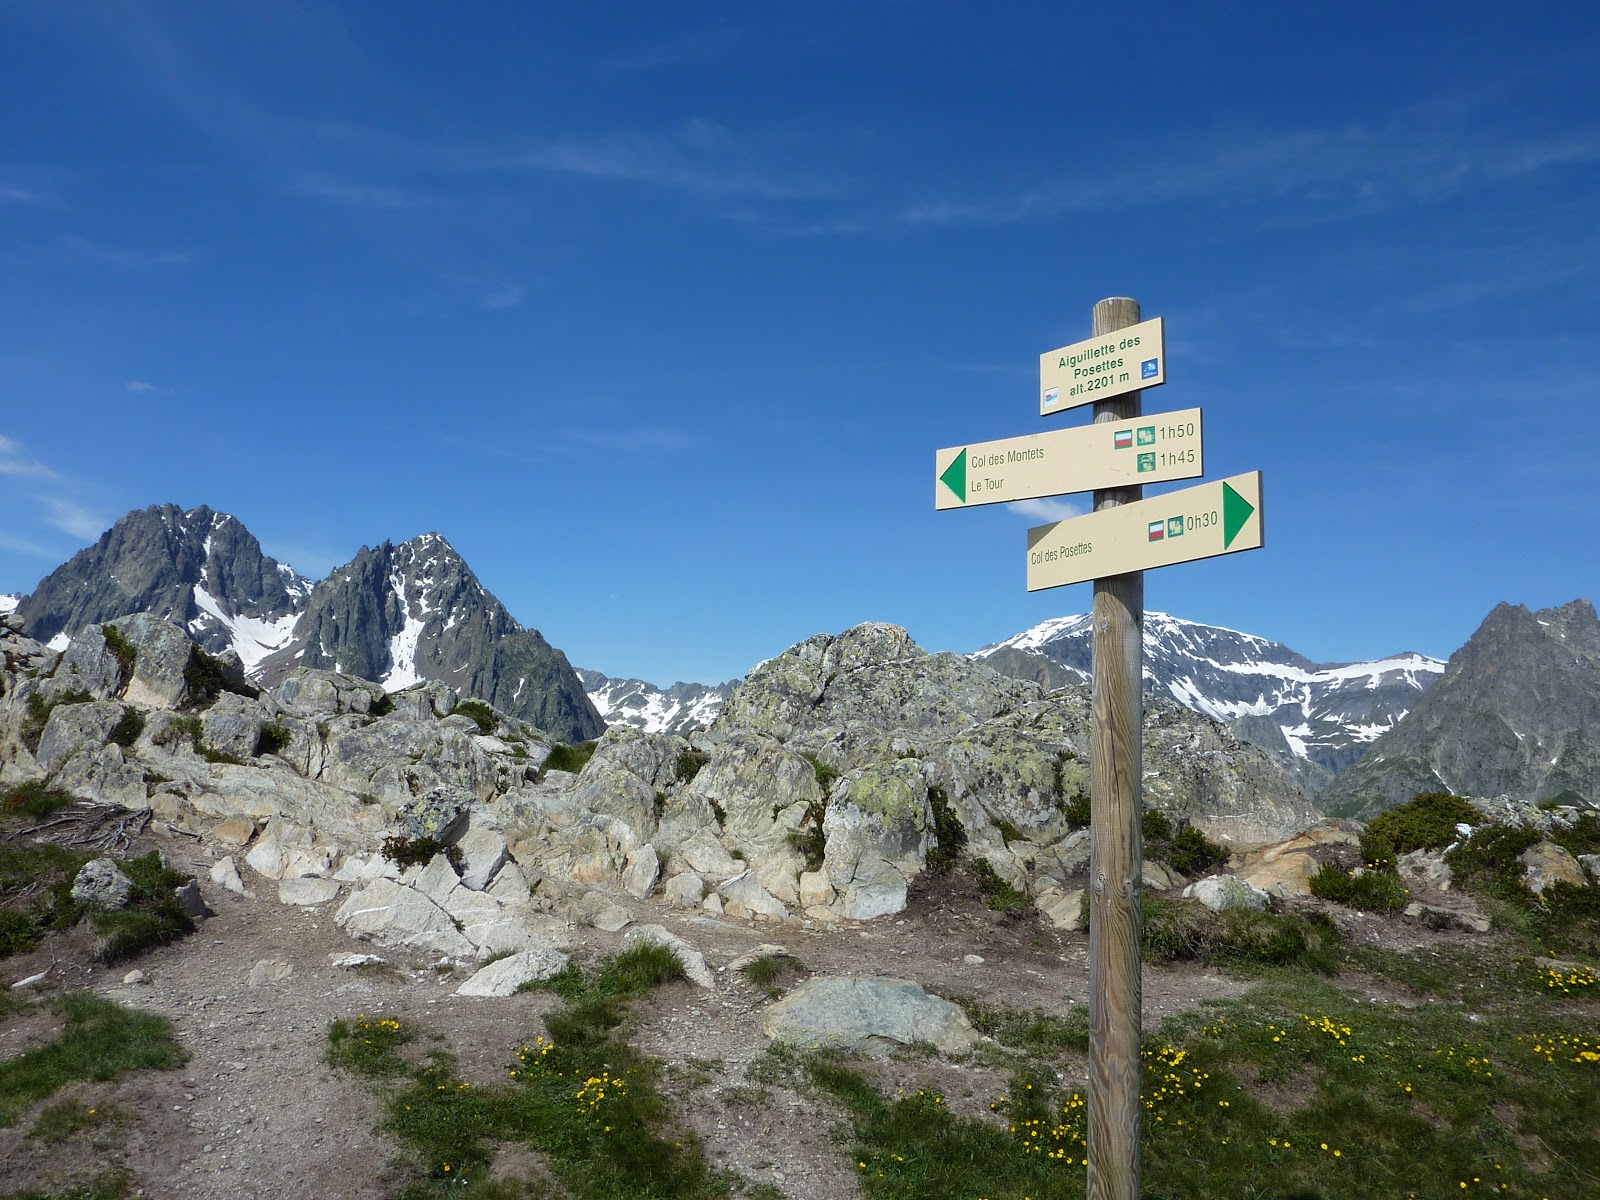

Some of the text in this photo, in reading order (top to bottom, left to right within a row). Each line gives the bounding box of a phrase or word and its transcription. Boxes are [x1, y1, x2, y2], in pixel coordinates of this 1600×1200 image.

[1058, 336, 1140, 368] Aiguillette des
[1074, 358, 1124, 379] Posettes
[1069, 375, 1114, 396] alt.2201
[1119, 372, 1129, 383] m
[1159, 422, 1194, 440] 1h50
[971, 447, 1044, 468] Col des Montets
[1160, 449, 1195, 466] 1h45
[971, 477, 1004, 492] Le Tour
[1187, 510, 1218, 531] 0h30
[1031, 542, 1092, 565] Col des Posettes
